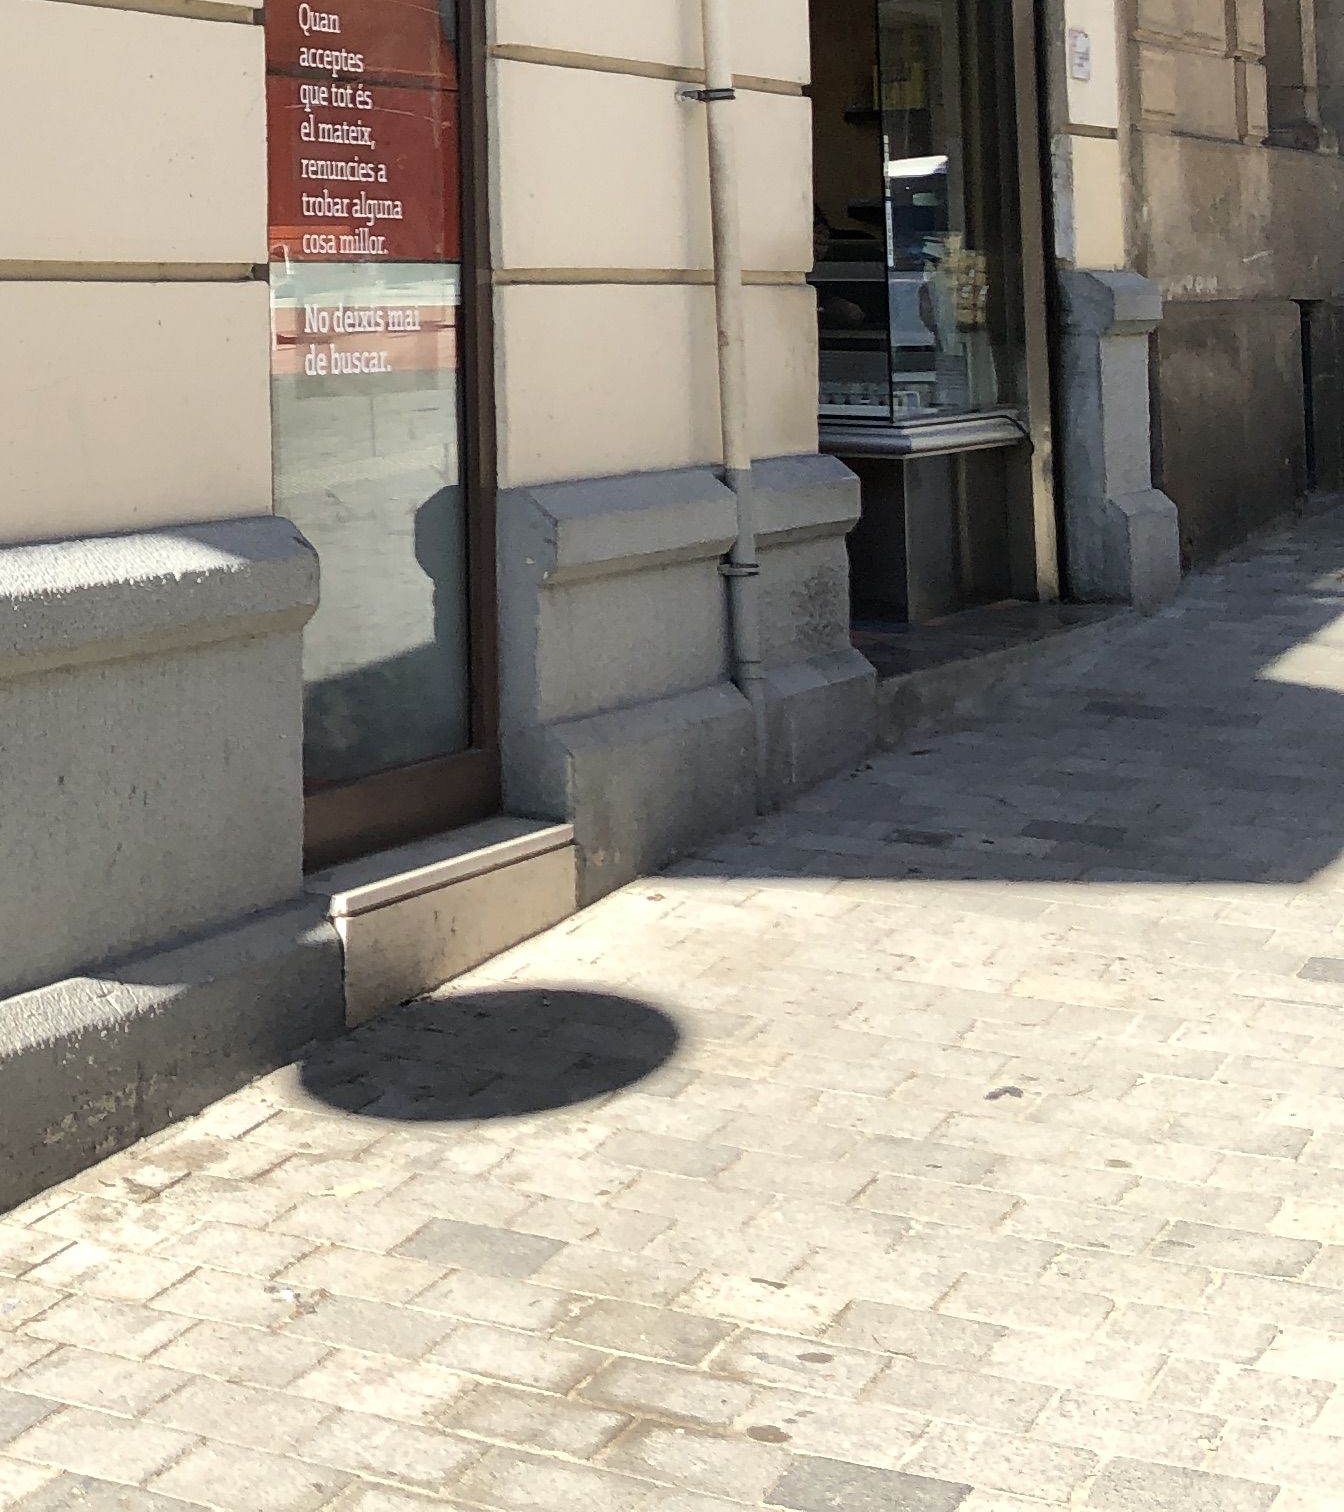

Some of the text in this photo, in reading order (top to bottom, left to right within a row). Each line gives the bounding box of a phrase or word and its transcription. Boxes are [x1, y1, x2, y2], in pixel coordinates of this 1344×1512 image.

[298, 3, 341, 36] Quan
[299, 46, 364, 77] acceptes
[300, 84, 329, 113] que
[332, 86, 354, 108] tot
[300, 114, 376, 149] el mateix,
[301, 156, 388, 183] renuncies a
[302, 189, 403, 226] trobar alguna
[302, 228, 389, 255] cosa millor.
[304, 303, 420, 333] No deixis mai
[305, 343, 392, 376] de buscar.
